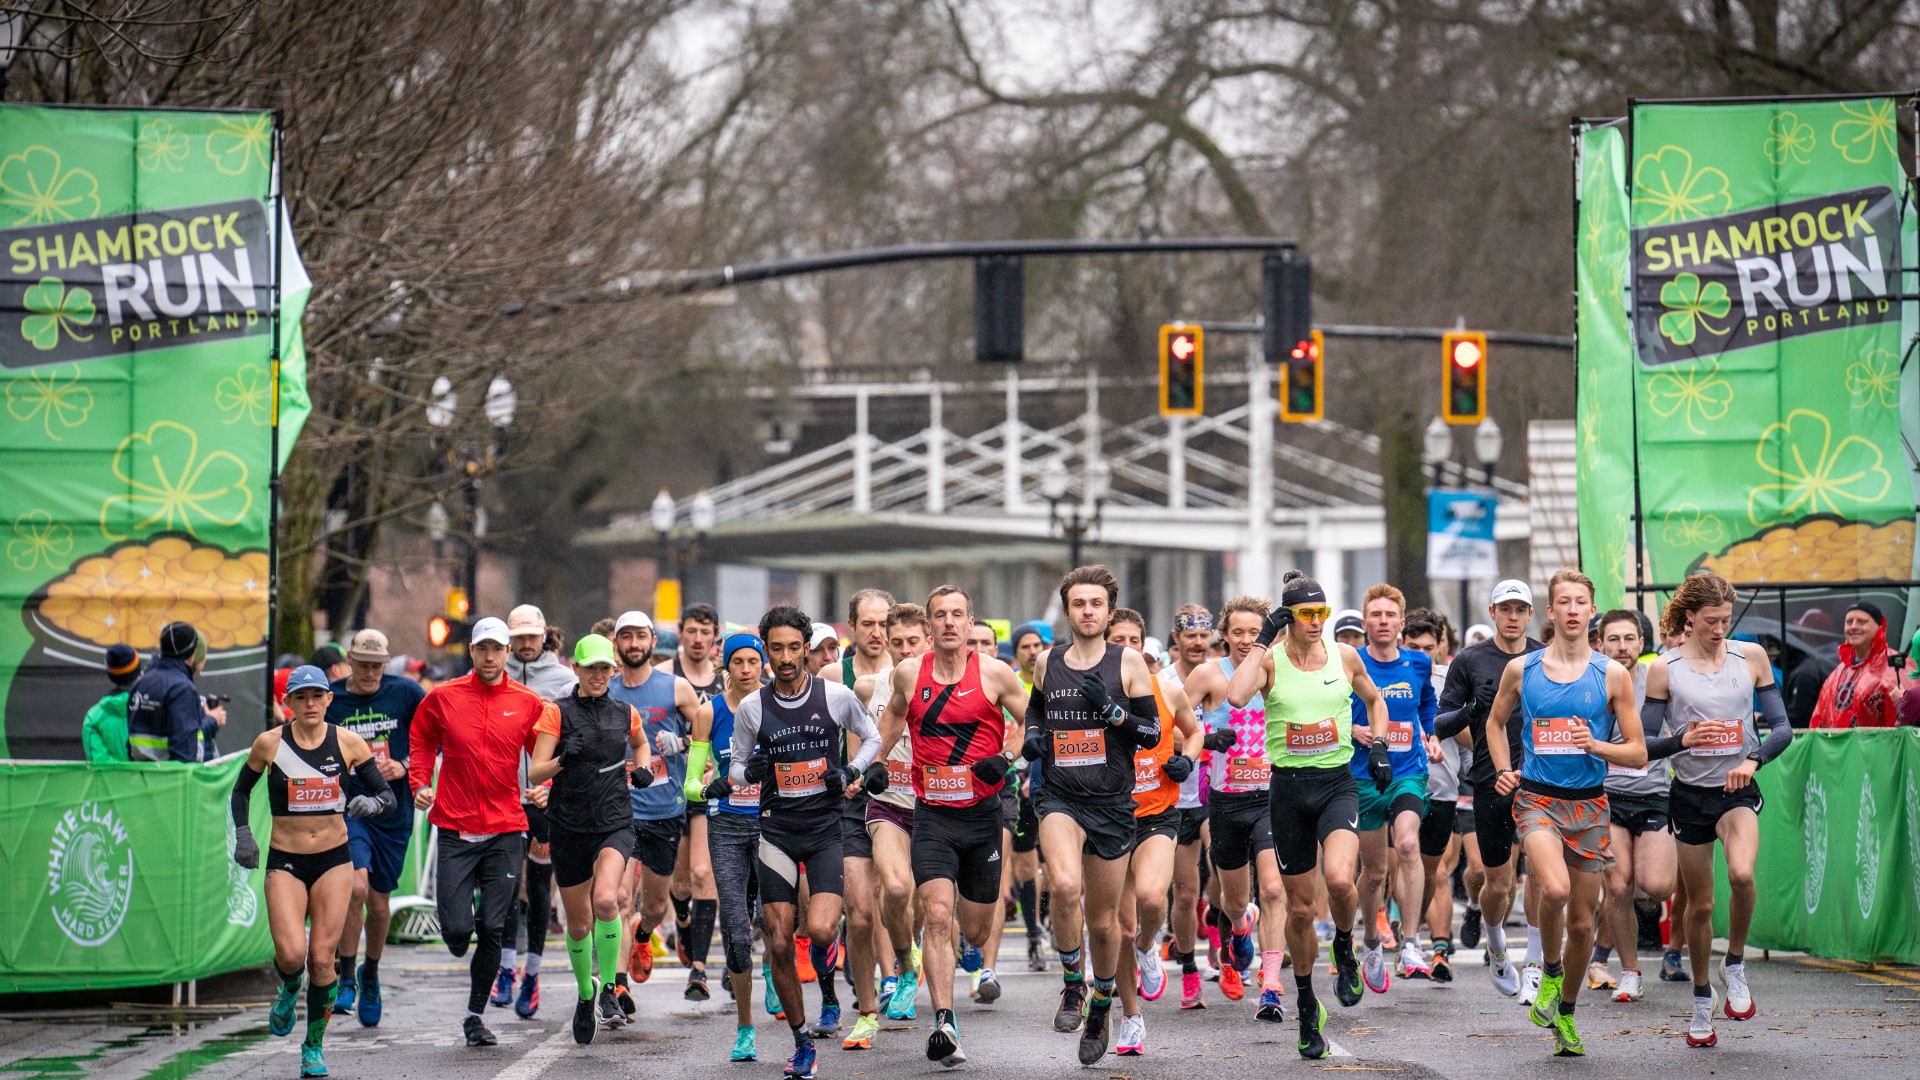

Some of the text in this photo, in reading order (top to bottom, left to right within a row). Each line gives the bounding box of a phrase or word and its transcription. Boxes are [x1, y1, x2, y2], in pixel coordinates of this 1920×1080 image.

[9, 211, 245, 274] SHAMROCK
[1645, 200, 1875, 271] SHAMROCK
[1735, 235, 1887, 317] RUN
[102, 248, 256, 325] RUN
[1747, 299, 1889, 336] PORTLAND
[111, 309, 259, 344] PORTLAND
[1379, 689, 1413, 699] IPPETS
[1047, 711, 1087, 720] ATHLETIC
[1319, 718, 1332, 728] 15K
[344, 719, 398, 735] AMROCK
[769, 725, 825, 742] JACUZZI BOYS
[1292, 731, 1333, 745] 21882
[1539, 731, 1573, 742] 2120
[769, 739, 829, 755] ATHLETIC CLUB
[1059, 742, 1099, 754] 20123
[784, 772, 820, 786] 20121
[929, 777, 966, 789] 21936
[296, 789, 332, 801] 21773
[48, 800, 128, 896] WHITE CLAW
[61, 864, 129, 938] HARD SELTZER
